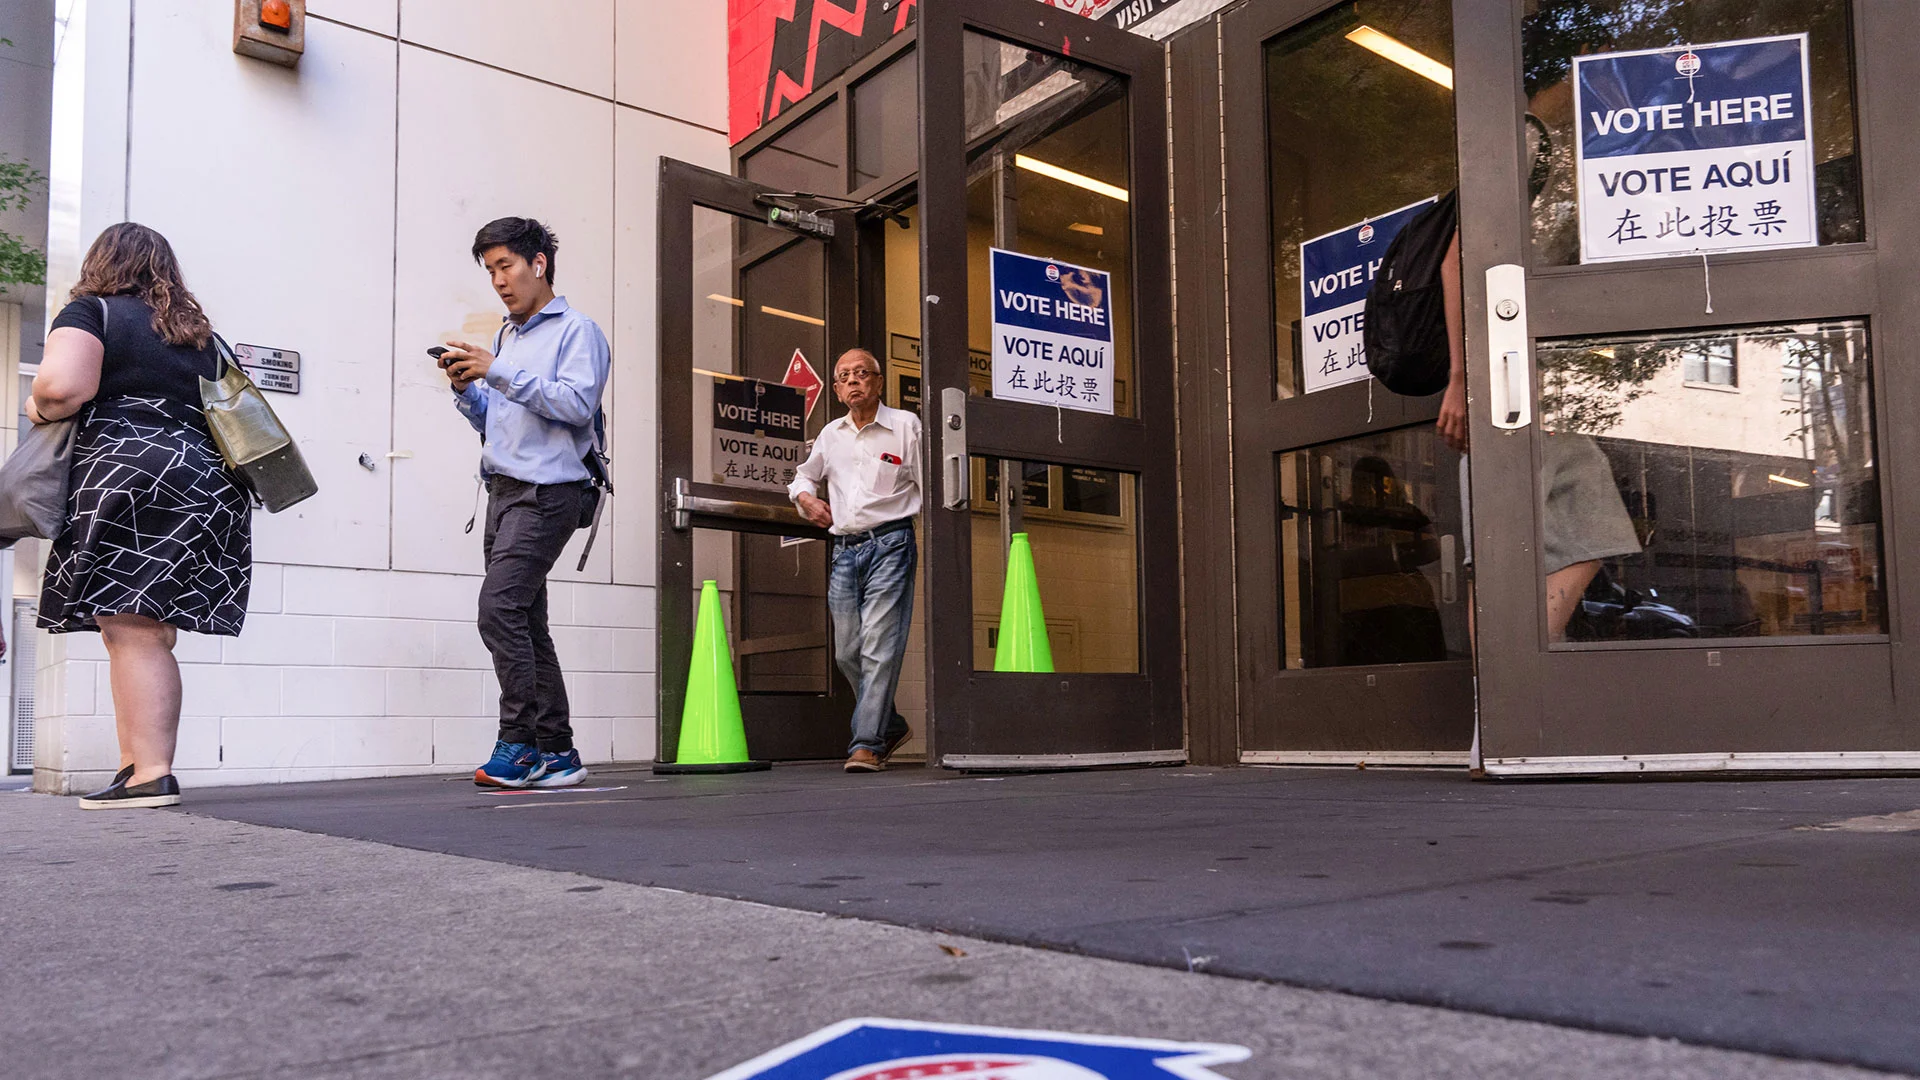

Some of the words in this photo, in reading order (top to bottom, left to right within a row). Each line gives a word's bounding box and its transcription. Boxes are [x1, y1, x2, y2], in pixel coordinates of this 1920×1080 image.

[1590, 103, 1684, 136] VOTE
[1693, 92, 1794, 128] HERE
[1598, 166, 1692, 198] VOTE
[1702, 150, 1793, 190] AQUÍ
[1607, 199, 1788, 245] 在此投票
[1309, 264, 1363, 299] VOTE
[999, 289, 1051, 316] VOTE
[1055, 299, 1106, 327] HERE
[1313, 311, 1365, 343] VOTE
[261, 358, 293, 368] SMOKING
[1003, 335, 1053, 361] VOTE
[1058, 346, 1104, 369] AQUÍ
[1319, 342, 1368, 377] 在此
[275, 381, 293, 389] PHONE
[1007, 364, 1100, 403] 在此投票
[718, 402, 759, 423] VOTE
[760, 410, 801, 430] HERE
[720, 437, 758, 457] VOTE
[762, 445, 798, 463] AQUÍ
[723, 459, 795, 486] 在此投票
